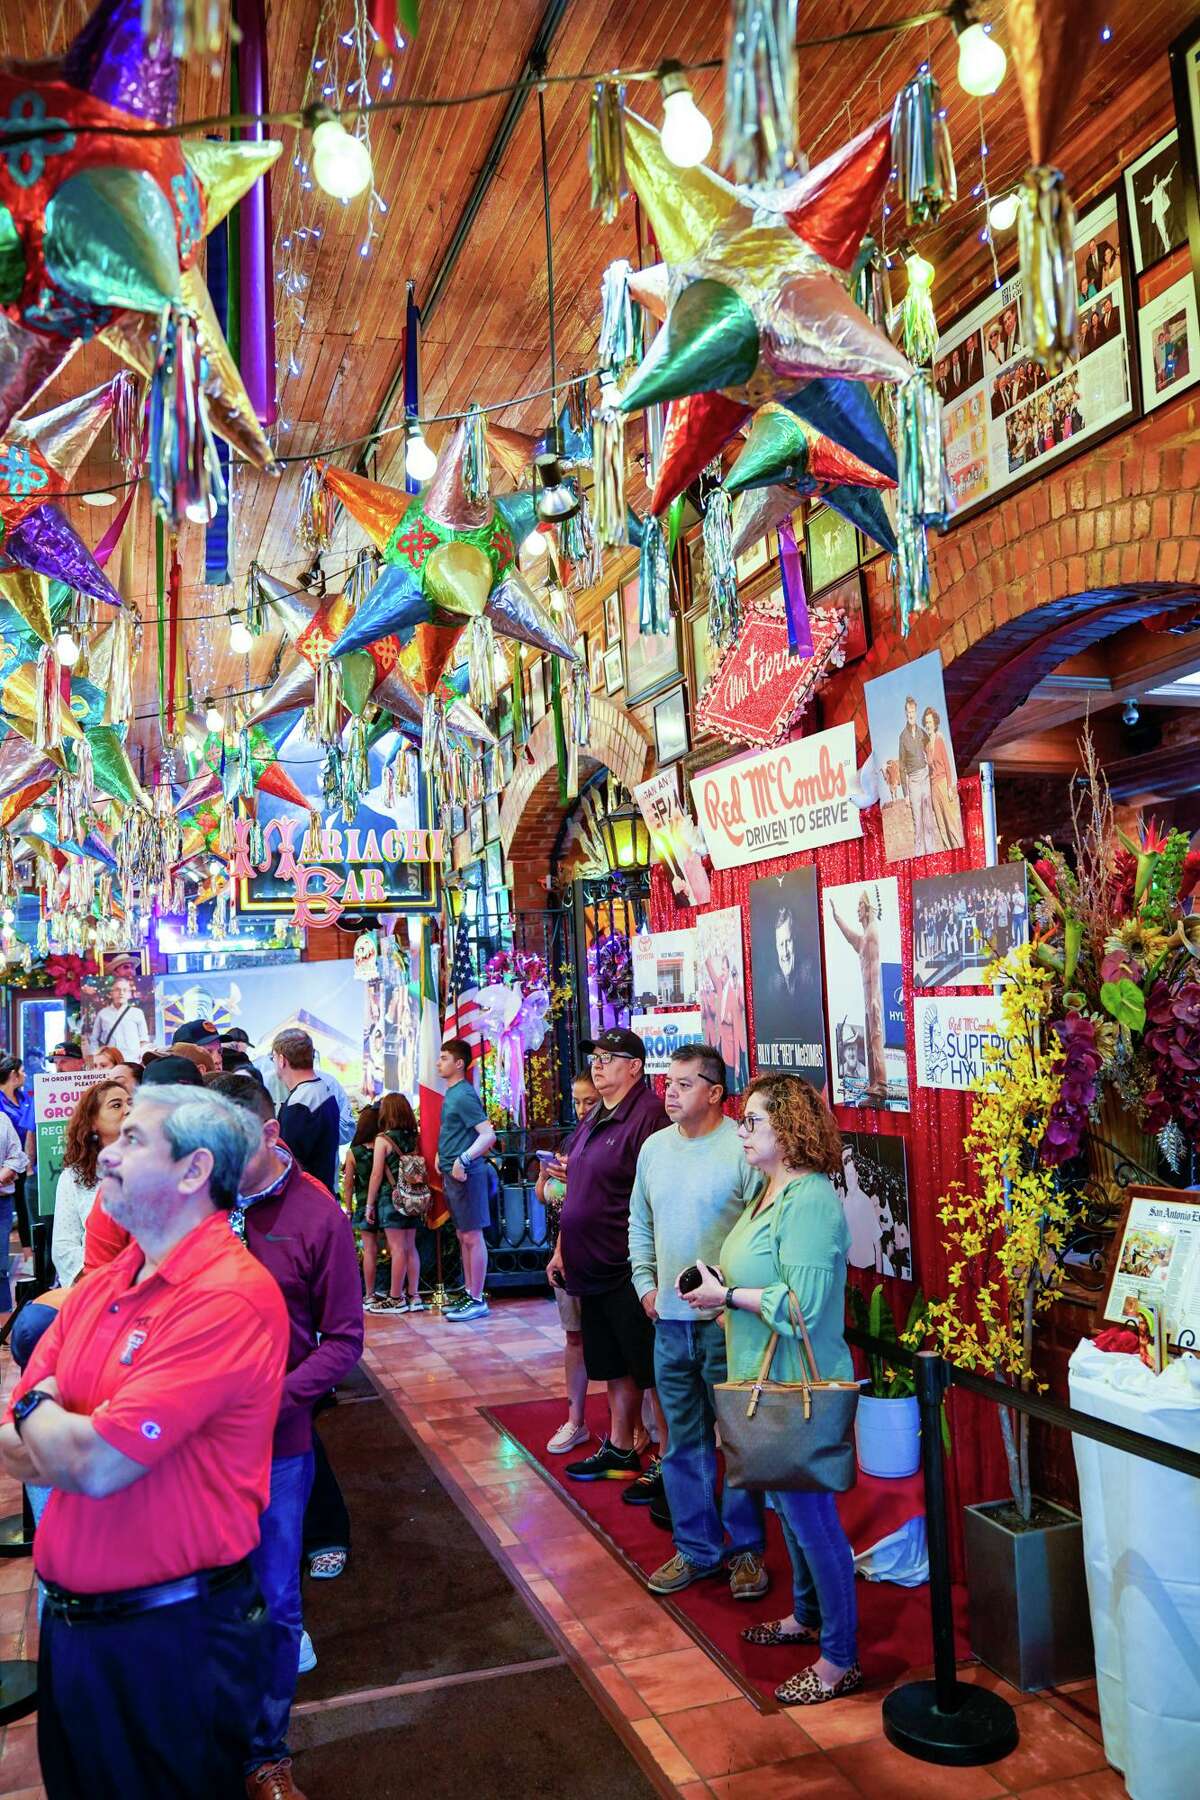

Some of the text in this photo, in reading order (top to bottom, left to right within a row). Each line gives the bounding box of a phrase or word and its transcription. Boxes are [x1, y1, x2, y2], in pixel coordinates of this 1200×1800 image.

[704, 775, 746, 847] Red
[741, 745, 847, 819] McCombs
[745, 802, 849, 847] DRIVEN TO SERVE
[231, 816, 444, 881] MARIACHI
[289, 864, 388, 929] BAR
[948, 1016, 962, 1036] Red
[946, 1033, 1031, 1061] SUPERIO
[43, 1106, 74, 1119] GRO
[48, 1093, 57, 1104] 2
[1148, 1205, 1163, 1217] San
[1163, 1207, 1191, 1221] Antonio
